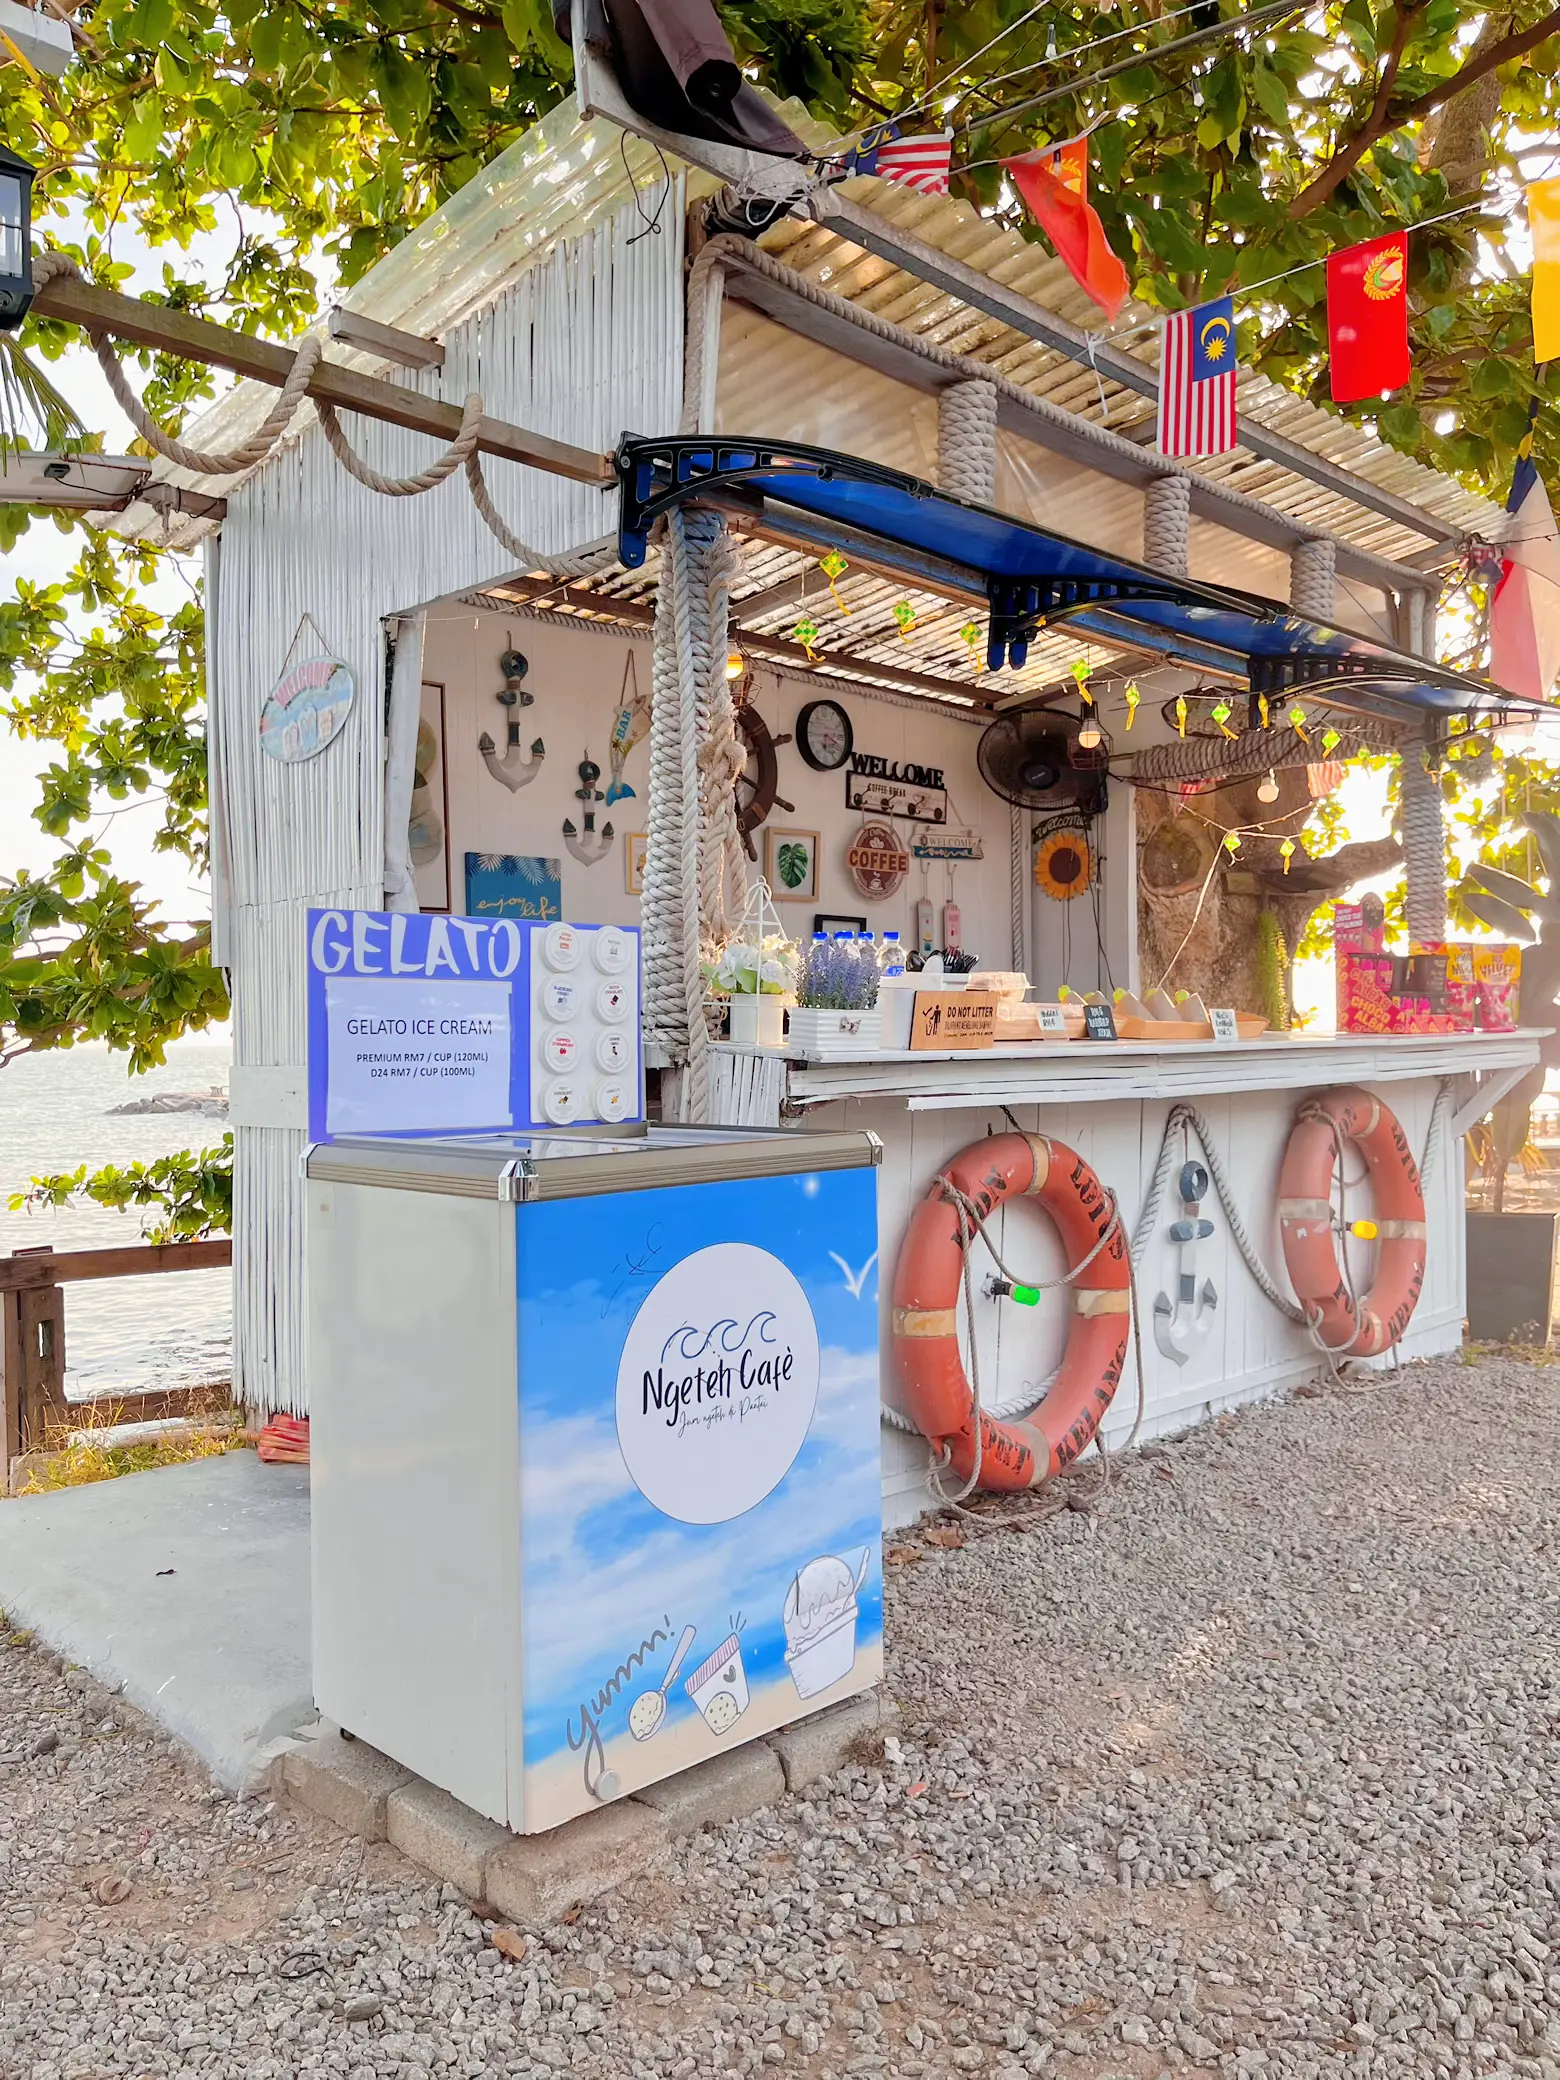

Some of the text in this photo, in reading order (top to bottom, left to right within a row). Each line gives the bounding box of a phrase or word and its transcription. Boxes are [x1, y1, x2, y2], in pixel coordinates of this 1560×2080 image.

[617, 710, 631, 741] BAR
[850, 752, 944, 789] WELCOME
[929, 837, 974, 847] WELCOME
[849, 849, 907, 872] COFFEE
[476, 894, 559, 920] enjoy life
[311, 911, 521, 977] GELATO
[947, 1006, 994, 1018] DO NOT LITTER
[1351, 996, 1391, 1023] CHOCO
[346, 1018, 493, 1036] GELATO ICE CREAM
[356, 1051, 489, 1063] PREMIUM RM7 / CUP (120ML)
[370, 1066, 475, 1078] D24 RM7 / CUP (100ML)
[642, 1358, 731, 1428] Ngeteh
[702, 1405, 726, 1430] ngeteh
[728, 1405, 737, 1418] di
[739, 1395, 769, 1424] Pantai
